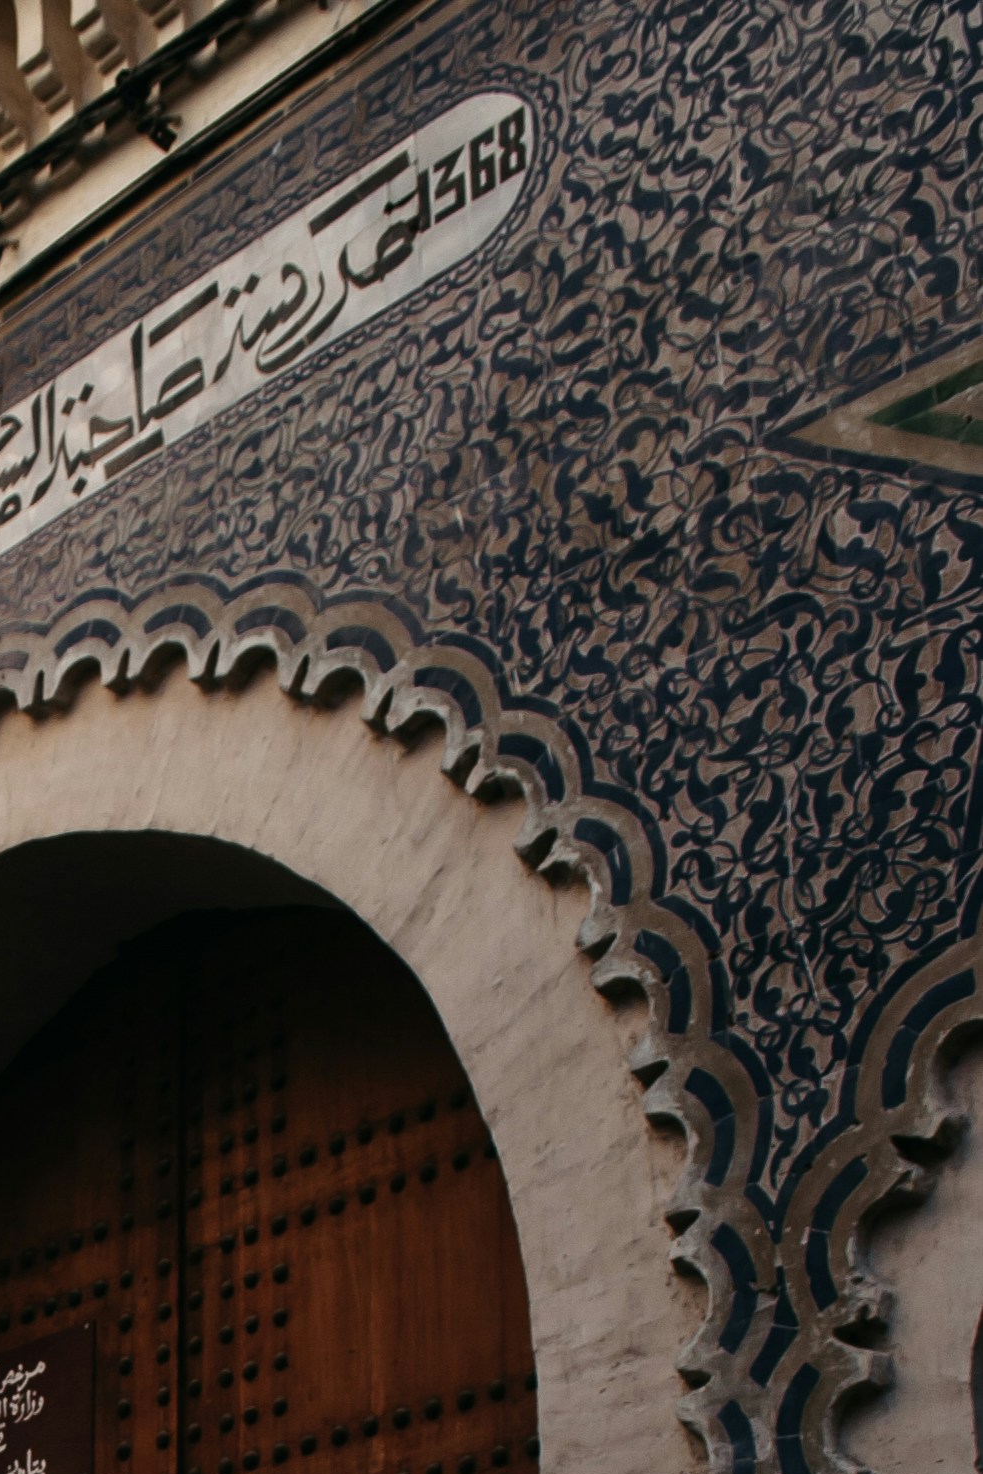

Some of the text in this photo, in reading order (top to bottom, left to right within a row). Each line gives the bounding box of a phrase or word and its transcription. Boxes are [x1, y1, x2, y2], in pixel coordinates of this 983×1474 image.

[416, 105, 527, 234] 1368
[212, 150, 419, 384] مدرسة
[30, 281, 218, 507] صاحبة
[10, 1389, 45, 1424] وزارة
